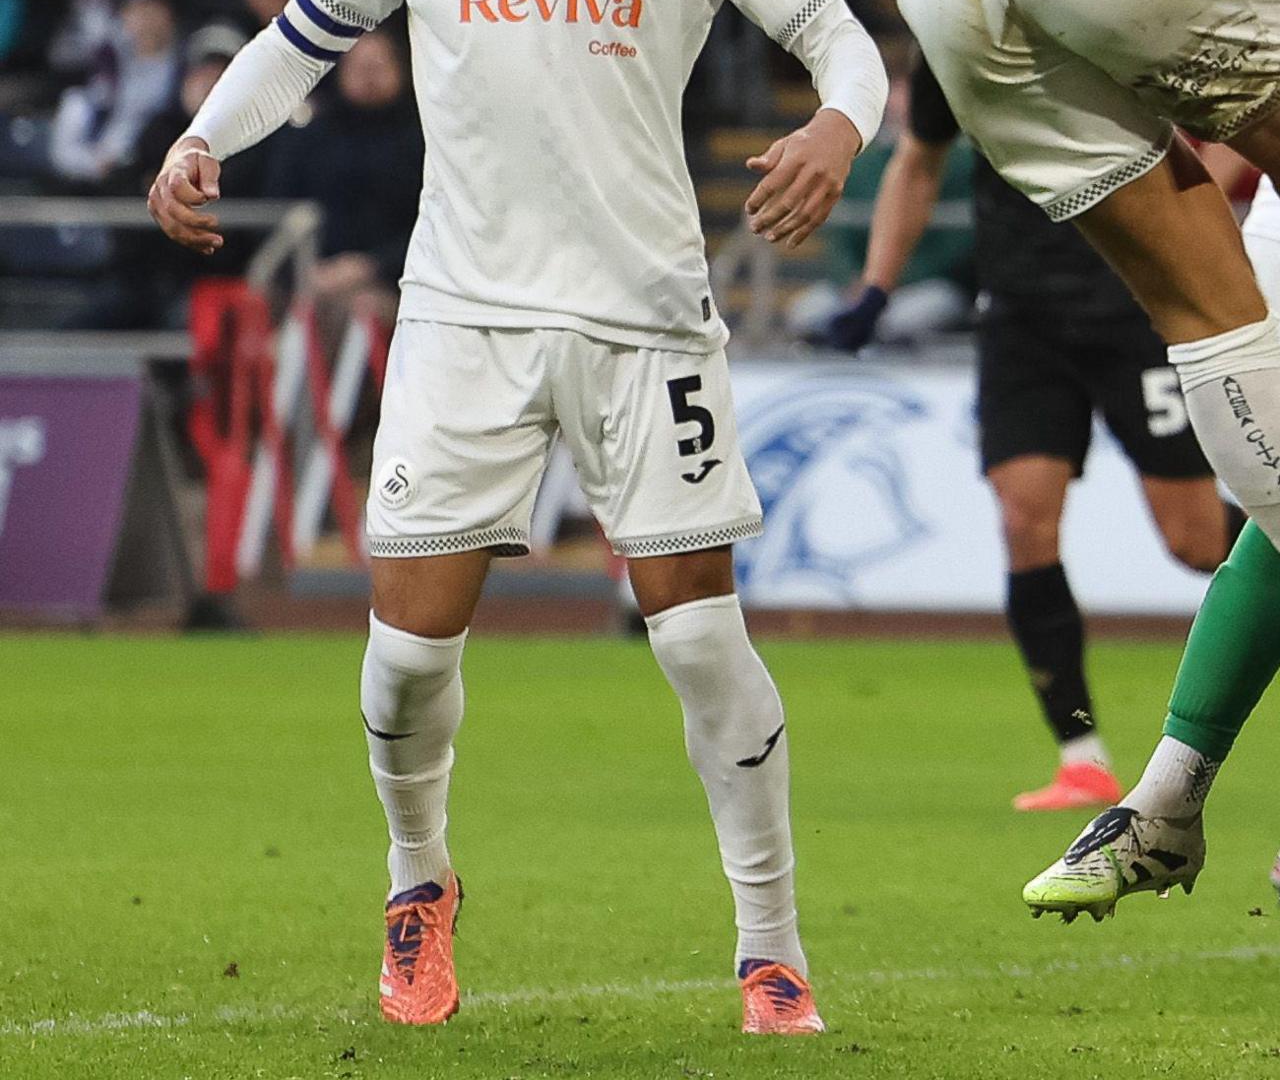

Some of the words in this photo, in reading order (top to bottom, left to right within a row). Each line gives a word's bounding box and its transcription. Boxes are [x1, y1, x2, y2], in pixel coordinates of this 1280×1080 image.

[588, 40, 637, 57] Coffee
[667, 374, 715, 456] 5
[1141, 366, 1188, 438] 5
